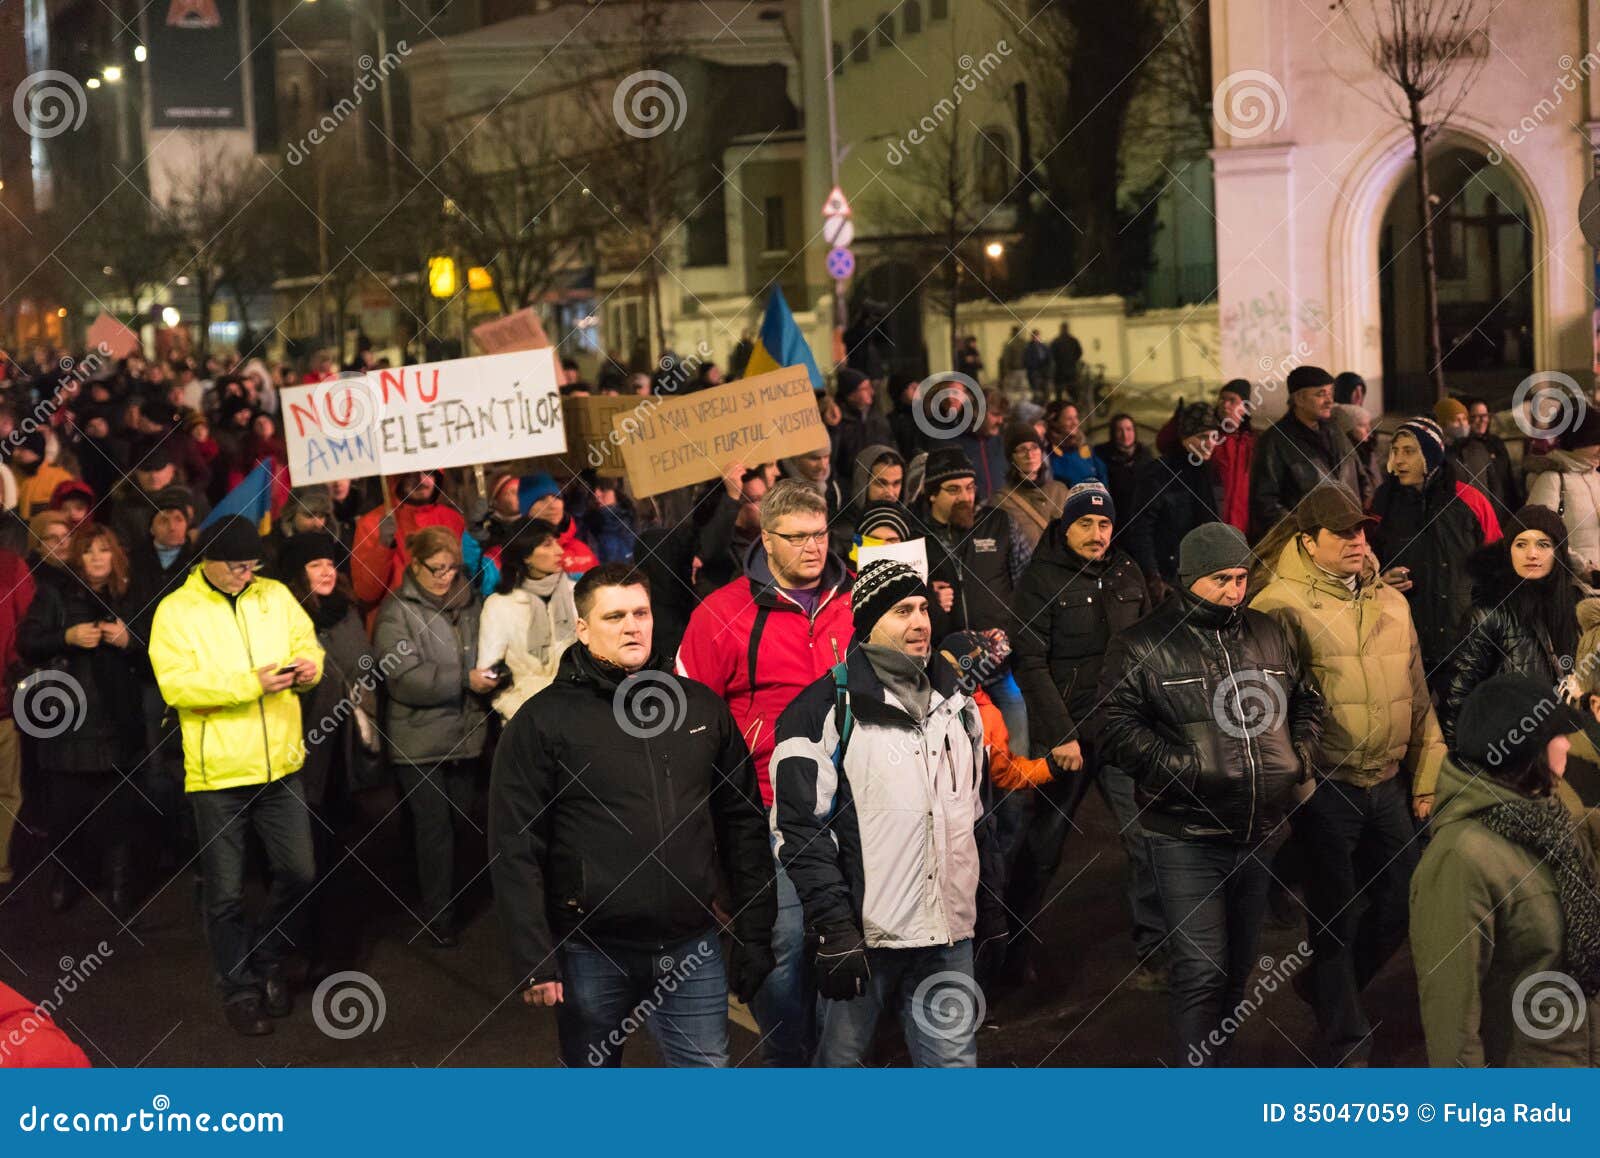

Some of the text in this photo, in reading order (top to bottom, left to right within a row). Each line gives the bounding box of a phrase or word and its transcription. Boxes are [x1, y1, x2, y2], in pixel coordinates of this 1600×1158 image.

[379, 368, 439, 404] NU
[289, 389, 353, 437] NU
[657, 406, 689, 435] MAI
[691, 395, 738, 424] VREAU
[307, 425, 375, 476] AMN
[713, 424, 769, 455] FURTUL
